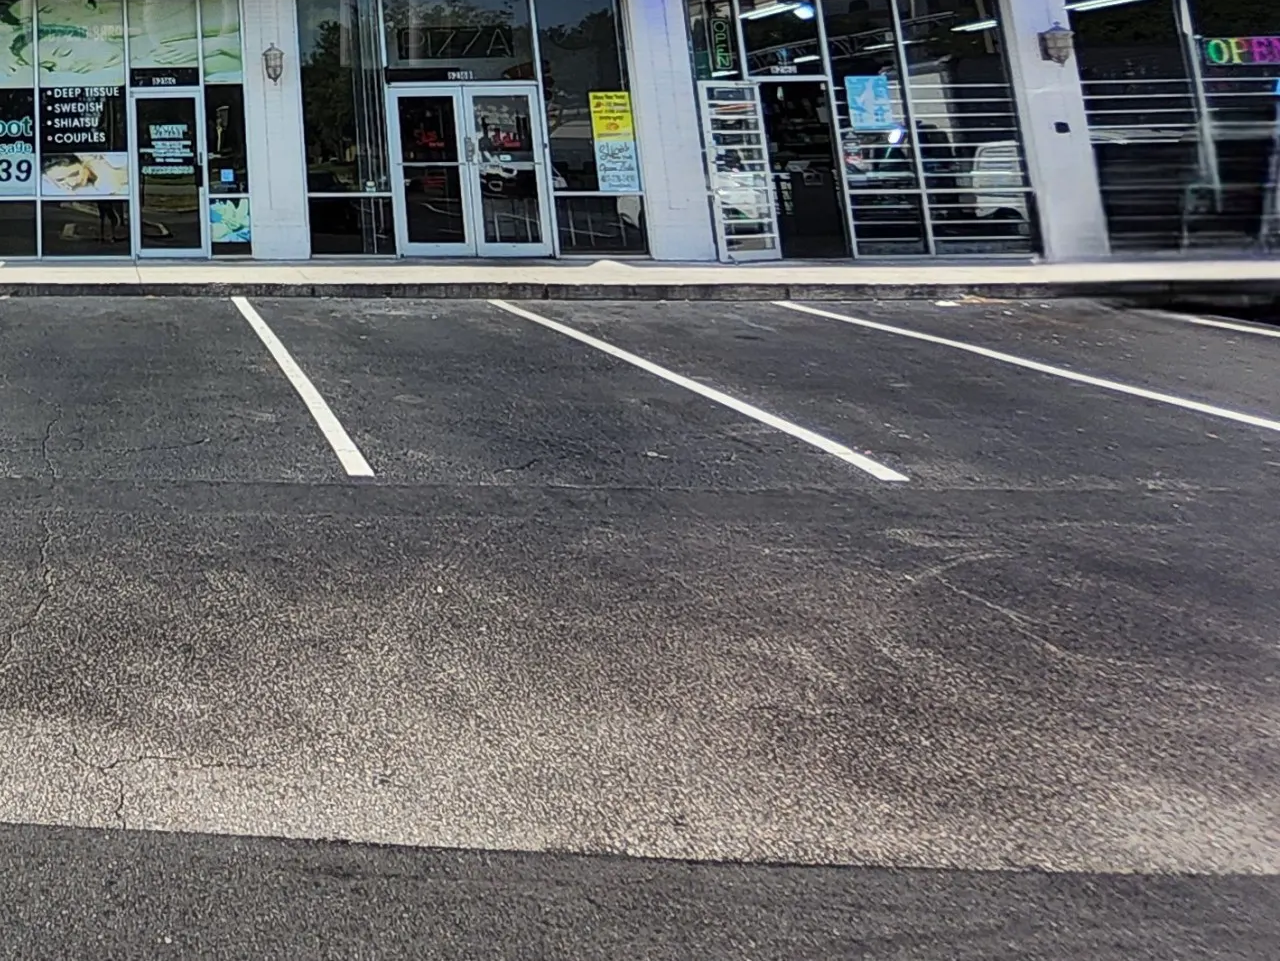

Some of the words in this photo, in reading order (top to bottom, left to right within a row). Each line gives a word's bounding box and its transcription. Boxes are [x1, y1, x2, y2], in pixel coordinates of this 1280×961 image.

[401, 27, 512, 57] PIZZA
[54, 88, 81, 98] DEEP
[85, 87, 120, 98] TISSUE
[54, 102, 103, 113] SWEDISH
[54, 118, 99, 128] SHIATSU
[55, 132, 106, 143] COUPLES
